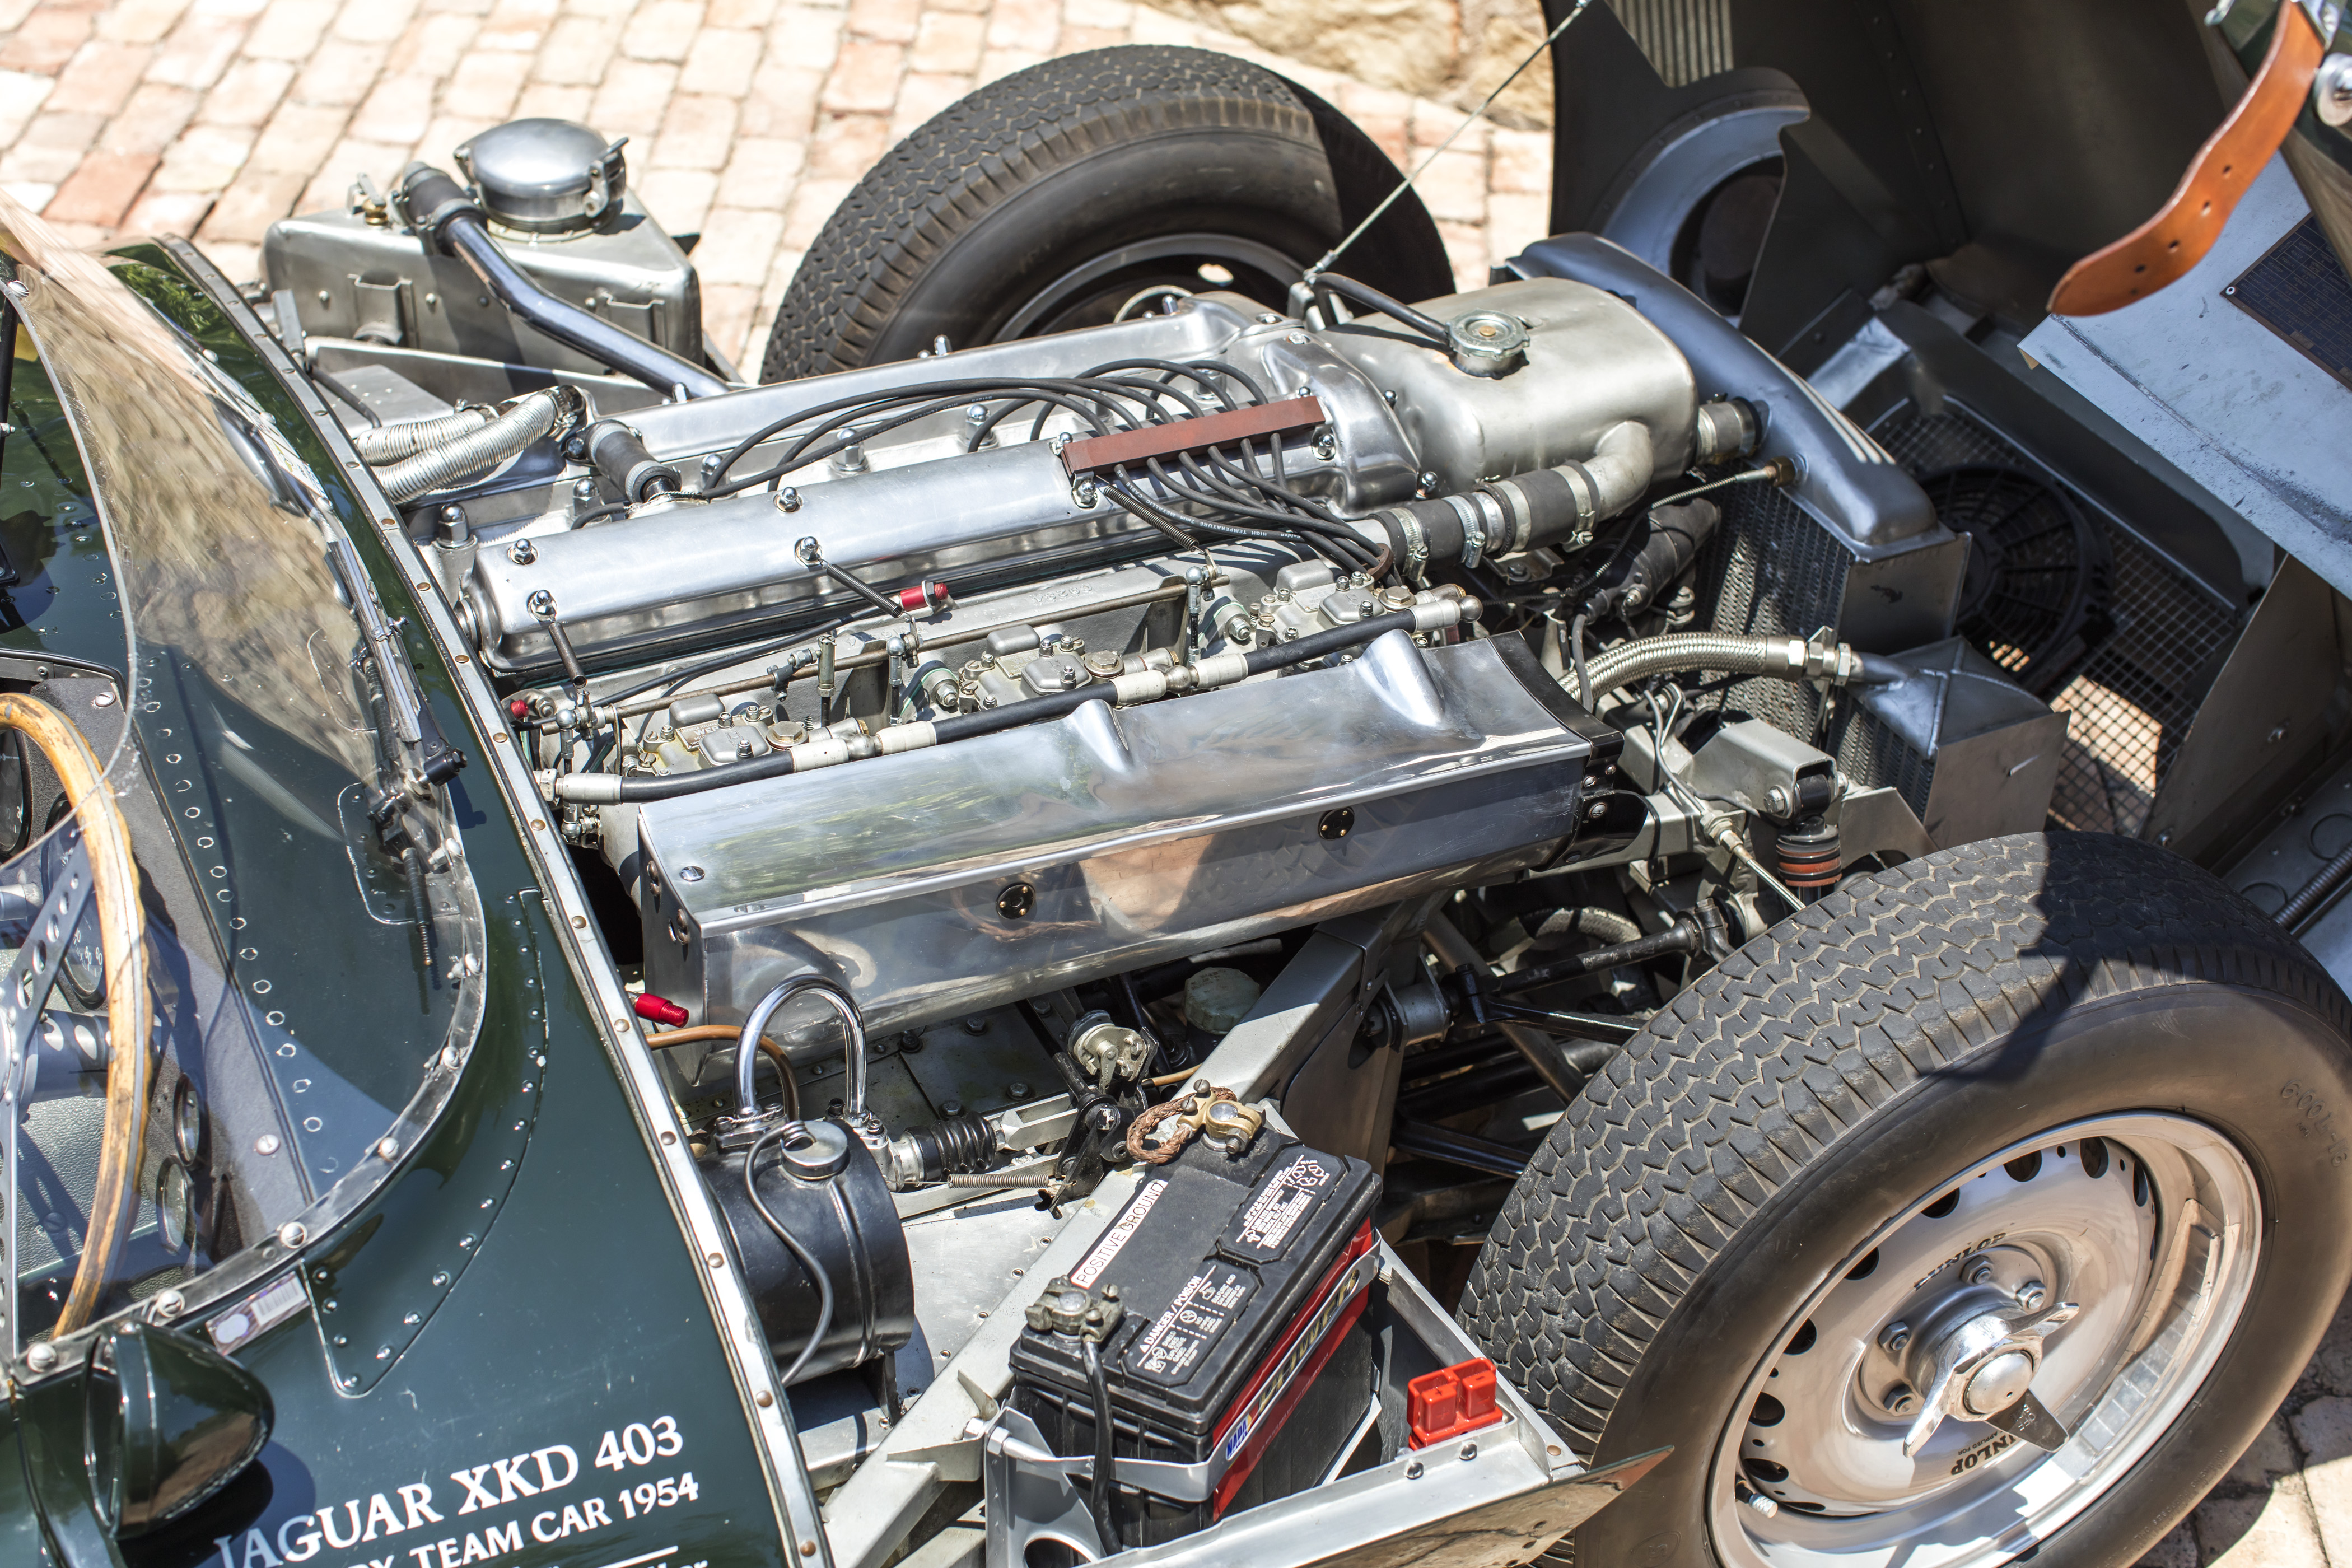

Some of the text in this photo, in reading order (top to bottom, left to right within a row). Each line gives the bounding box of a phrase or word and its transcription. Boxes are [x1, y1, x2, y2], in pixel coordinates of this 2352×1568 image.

[1125, 482, 1143, 497] CABLE
[1145, 499, 1175, 517] METALLIC
[1180, 515, 1194, 524] 7mm
[1200, 521, 1247, 534] TEMPERATURE
[1259, 1208, 1269, 1219] EYES
[1278, 1201, 1288, 1211] FAST
[1076, 1180, 1165, 1284] POSITIVE GROUND
[1225, 1273, 1236, 1285] ACID
[1143, 1309, 1174, 1344] DANGER
[1173, 1274, 1202, 1306] POISON
[1194, 1316, 1203, 1325] NO
[1161, 1329, 1177, 1346] SHIELD
[1167, 1336, 1179, 1348] EYES
[1165, 1336, 1187, 1360] EXPLOSIVE
[1172, 1346, 1187, 1362] GASES
[1227, 1418, 1248, 1459] NAPA
[1957, 1431, 1997, 1455] APPLIED FOR
[1952, 1434, 2016, 1474] NLOP
[214, 1416, 683, 1568] JAGUAR XKD 403
[409, 1472, 698, 1568] TEAM CAR 1954
